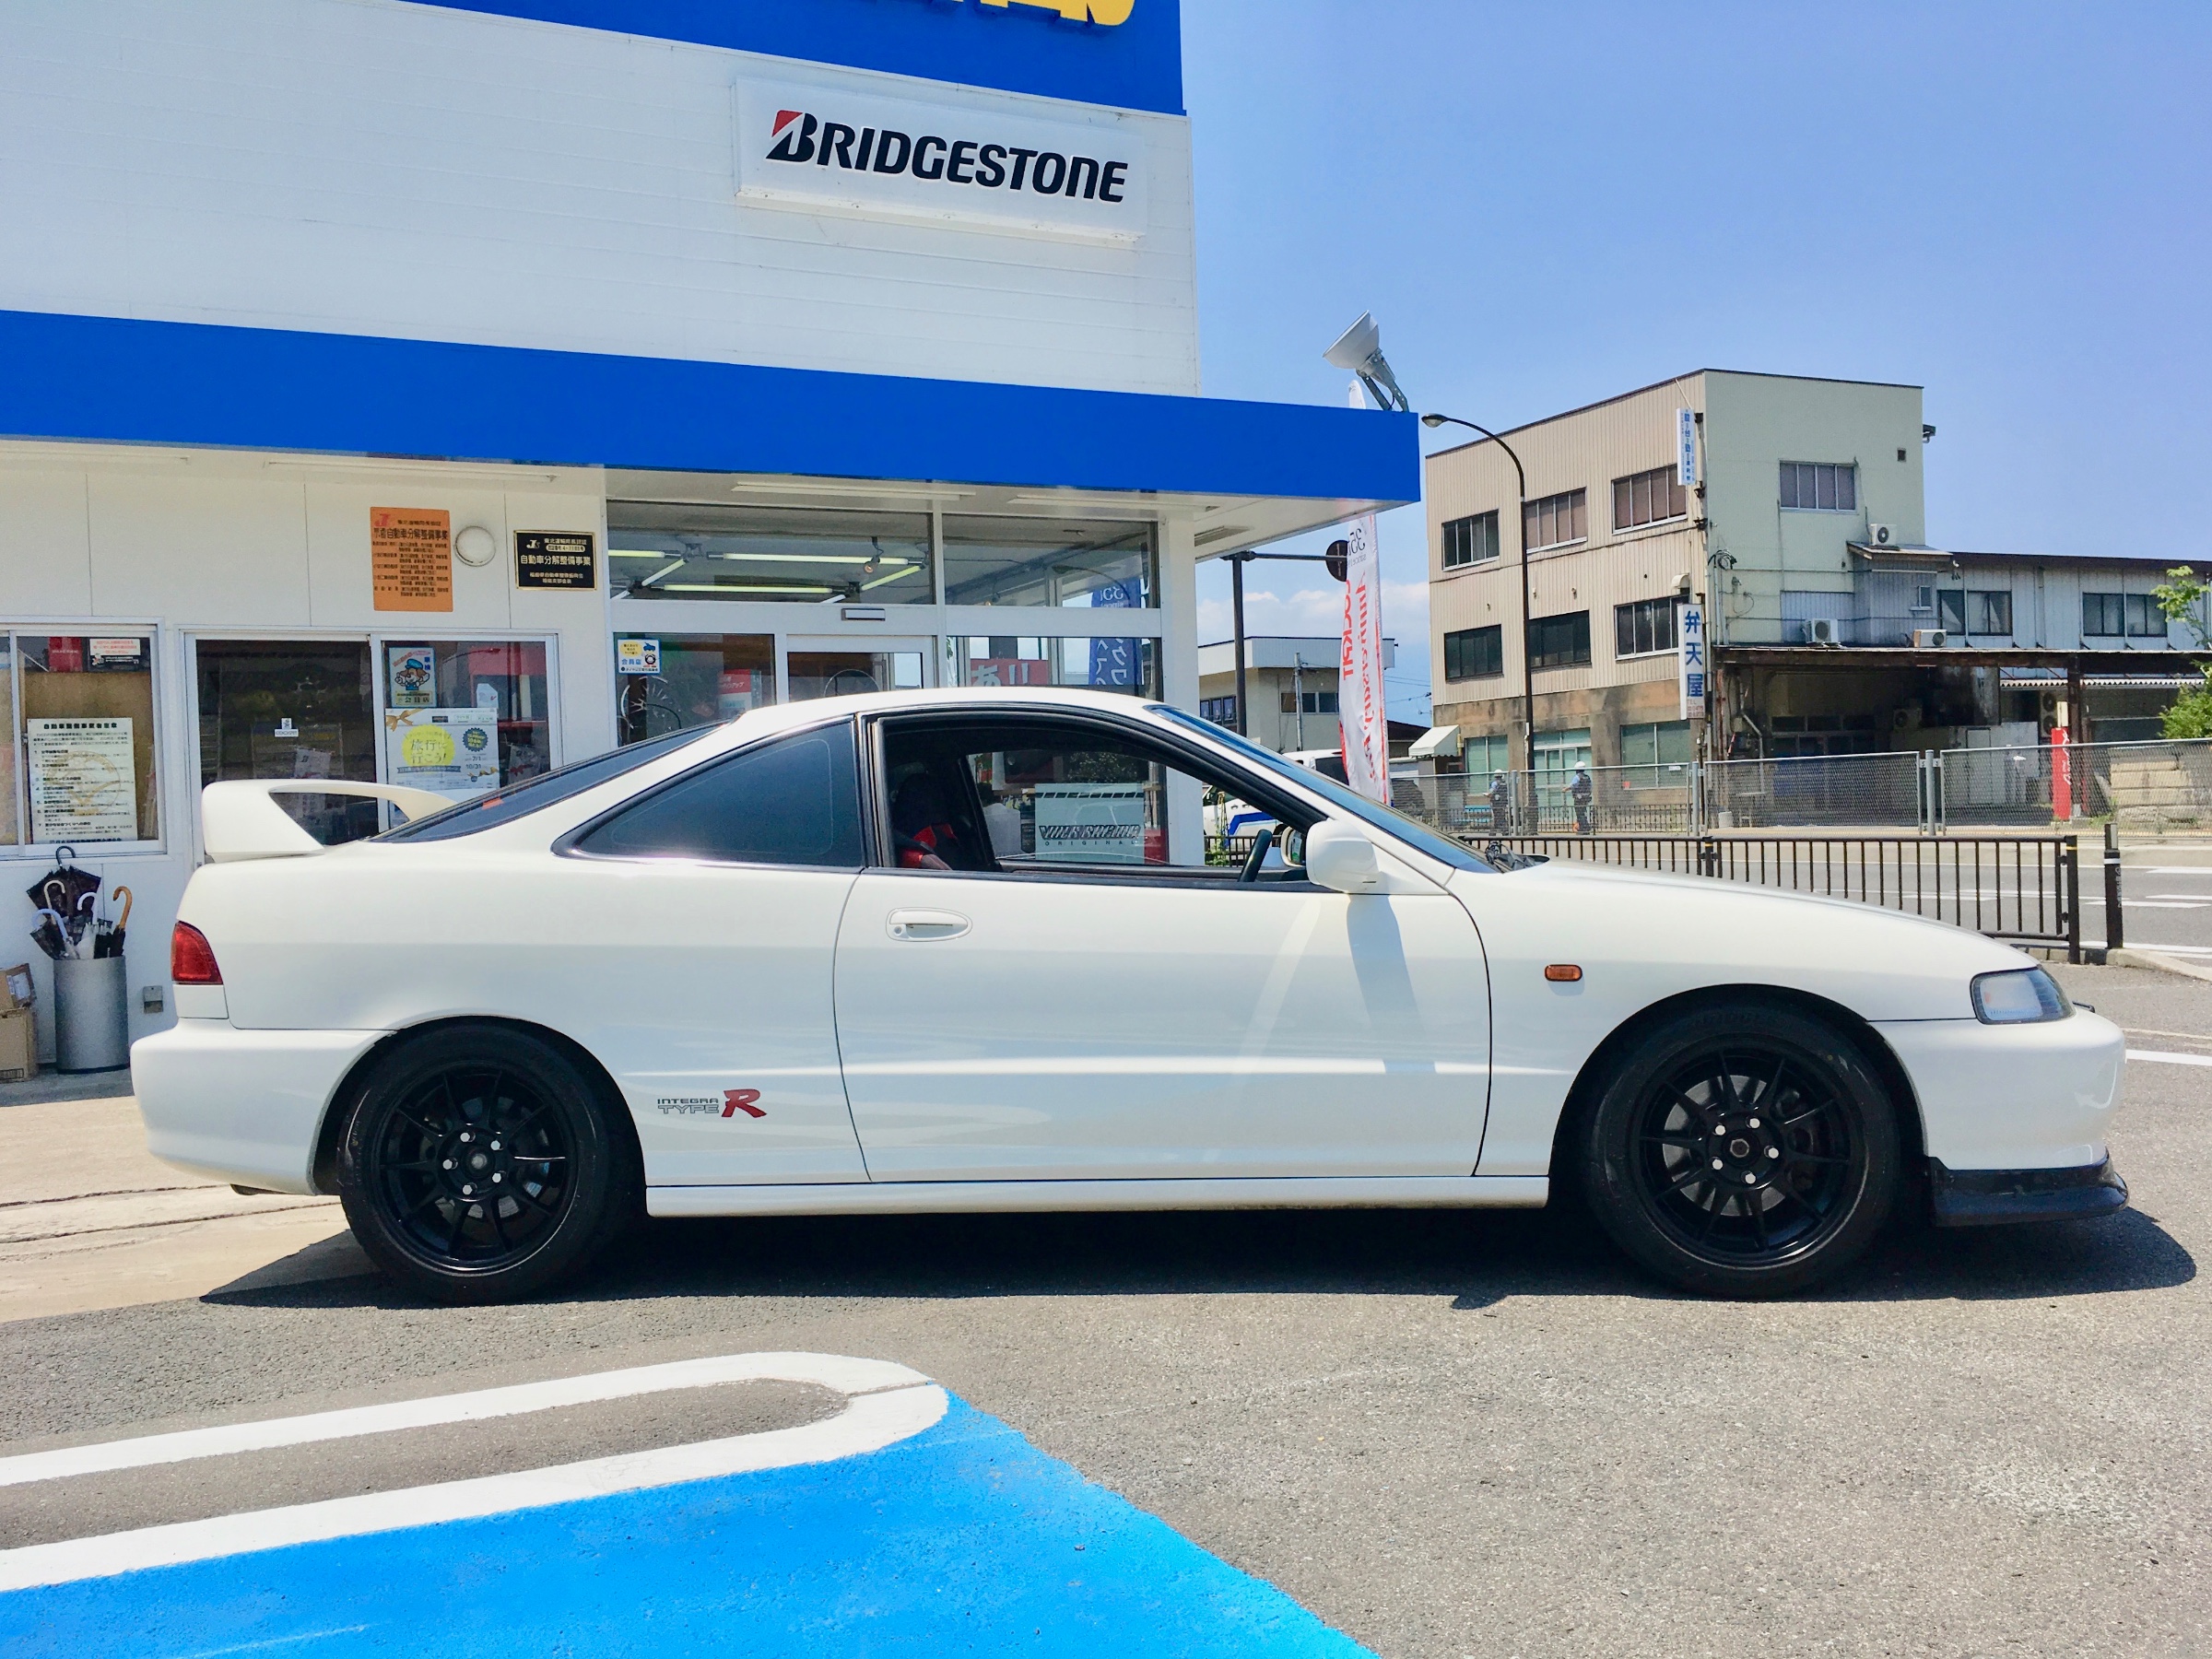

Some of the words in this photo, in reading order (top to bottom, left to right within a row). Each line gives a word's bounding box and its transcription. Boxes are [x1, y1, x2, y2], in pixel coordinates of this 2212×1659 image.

[766, 110, 1128, 203] BRIDGESTONE
[520, 554, 591, 566] 自動車分解整備事業
[1685, 610, 1704, 698] 弁天屋
[410, 738, 448, 750] 旅行に
[657, 1104, 719, 1114] TYPE
[721, 1088, 768, 1118] R
